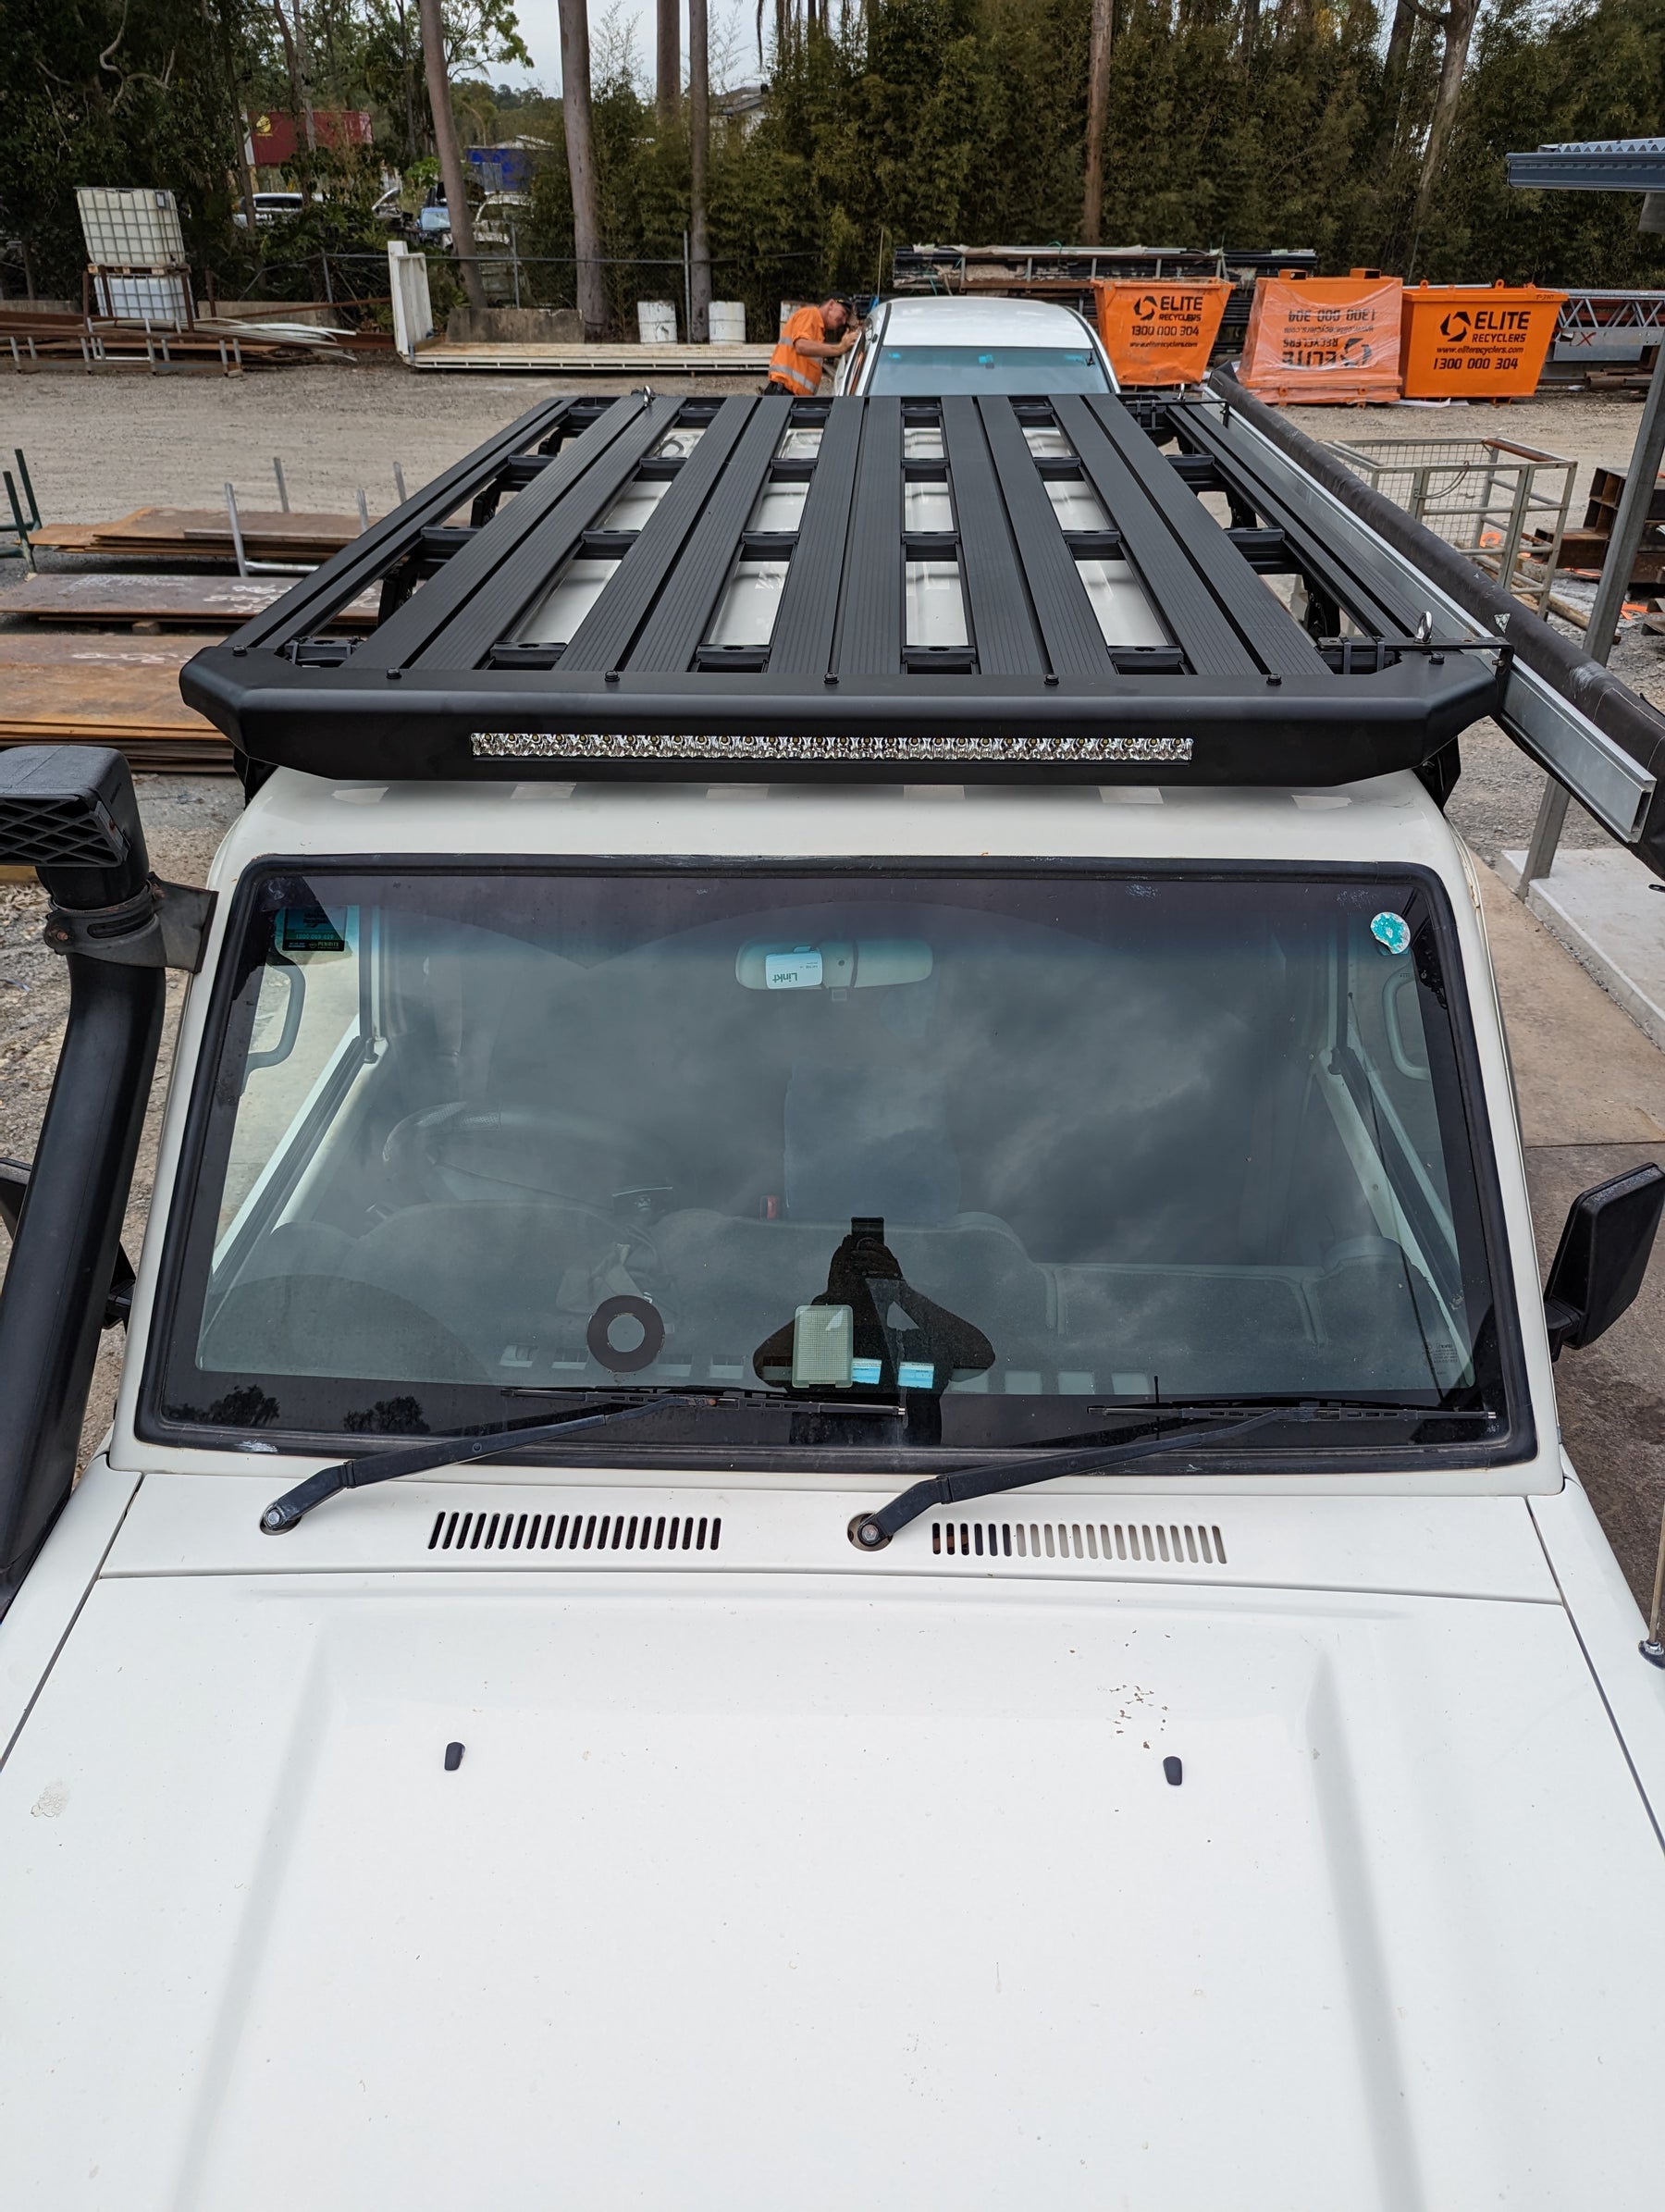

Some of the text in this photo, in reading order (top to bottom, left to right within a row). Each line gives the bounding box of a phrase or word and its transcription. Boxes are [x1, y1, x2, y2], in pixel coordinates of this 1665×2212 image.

[1160, 295, 1203, 311] ELITE
[1159, 313, 1202, 322] RECYCLERS
[1474, 311, 1531, 330] ELITE
[1131, 325, 1200, 337] 1300 000 304
[1472, 333, 1526, 343] RECYCLERS
[1437, 345, 1524, 355] www.eliterecyclers.com
[1282, 351, 1337, 366] ELITE
[1433, 357, 1519, 370] 1300 000 304
[772, 972, 797, 982] Linkt
